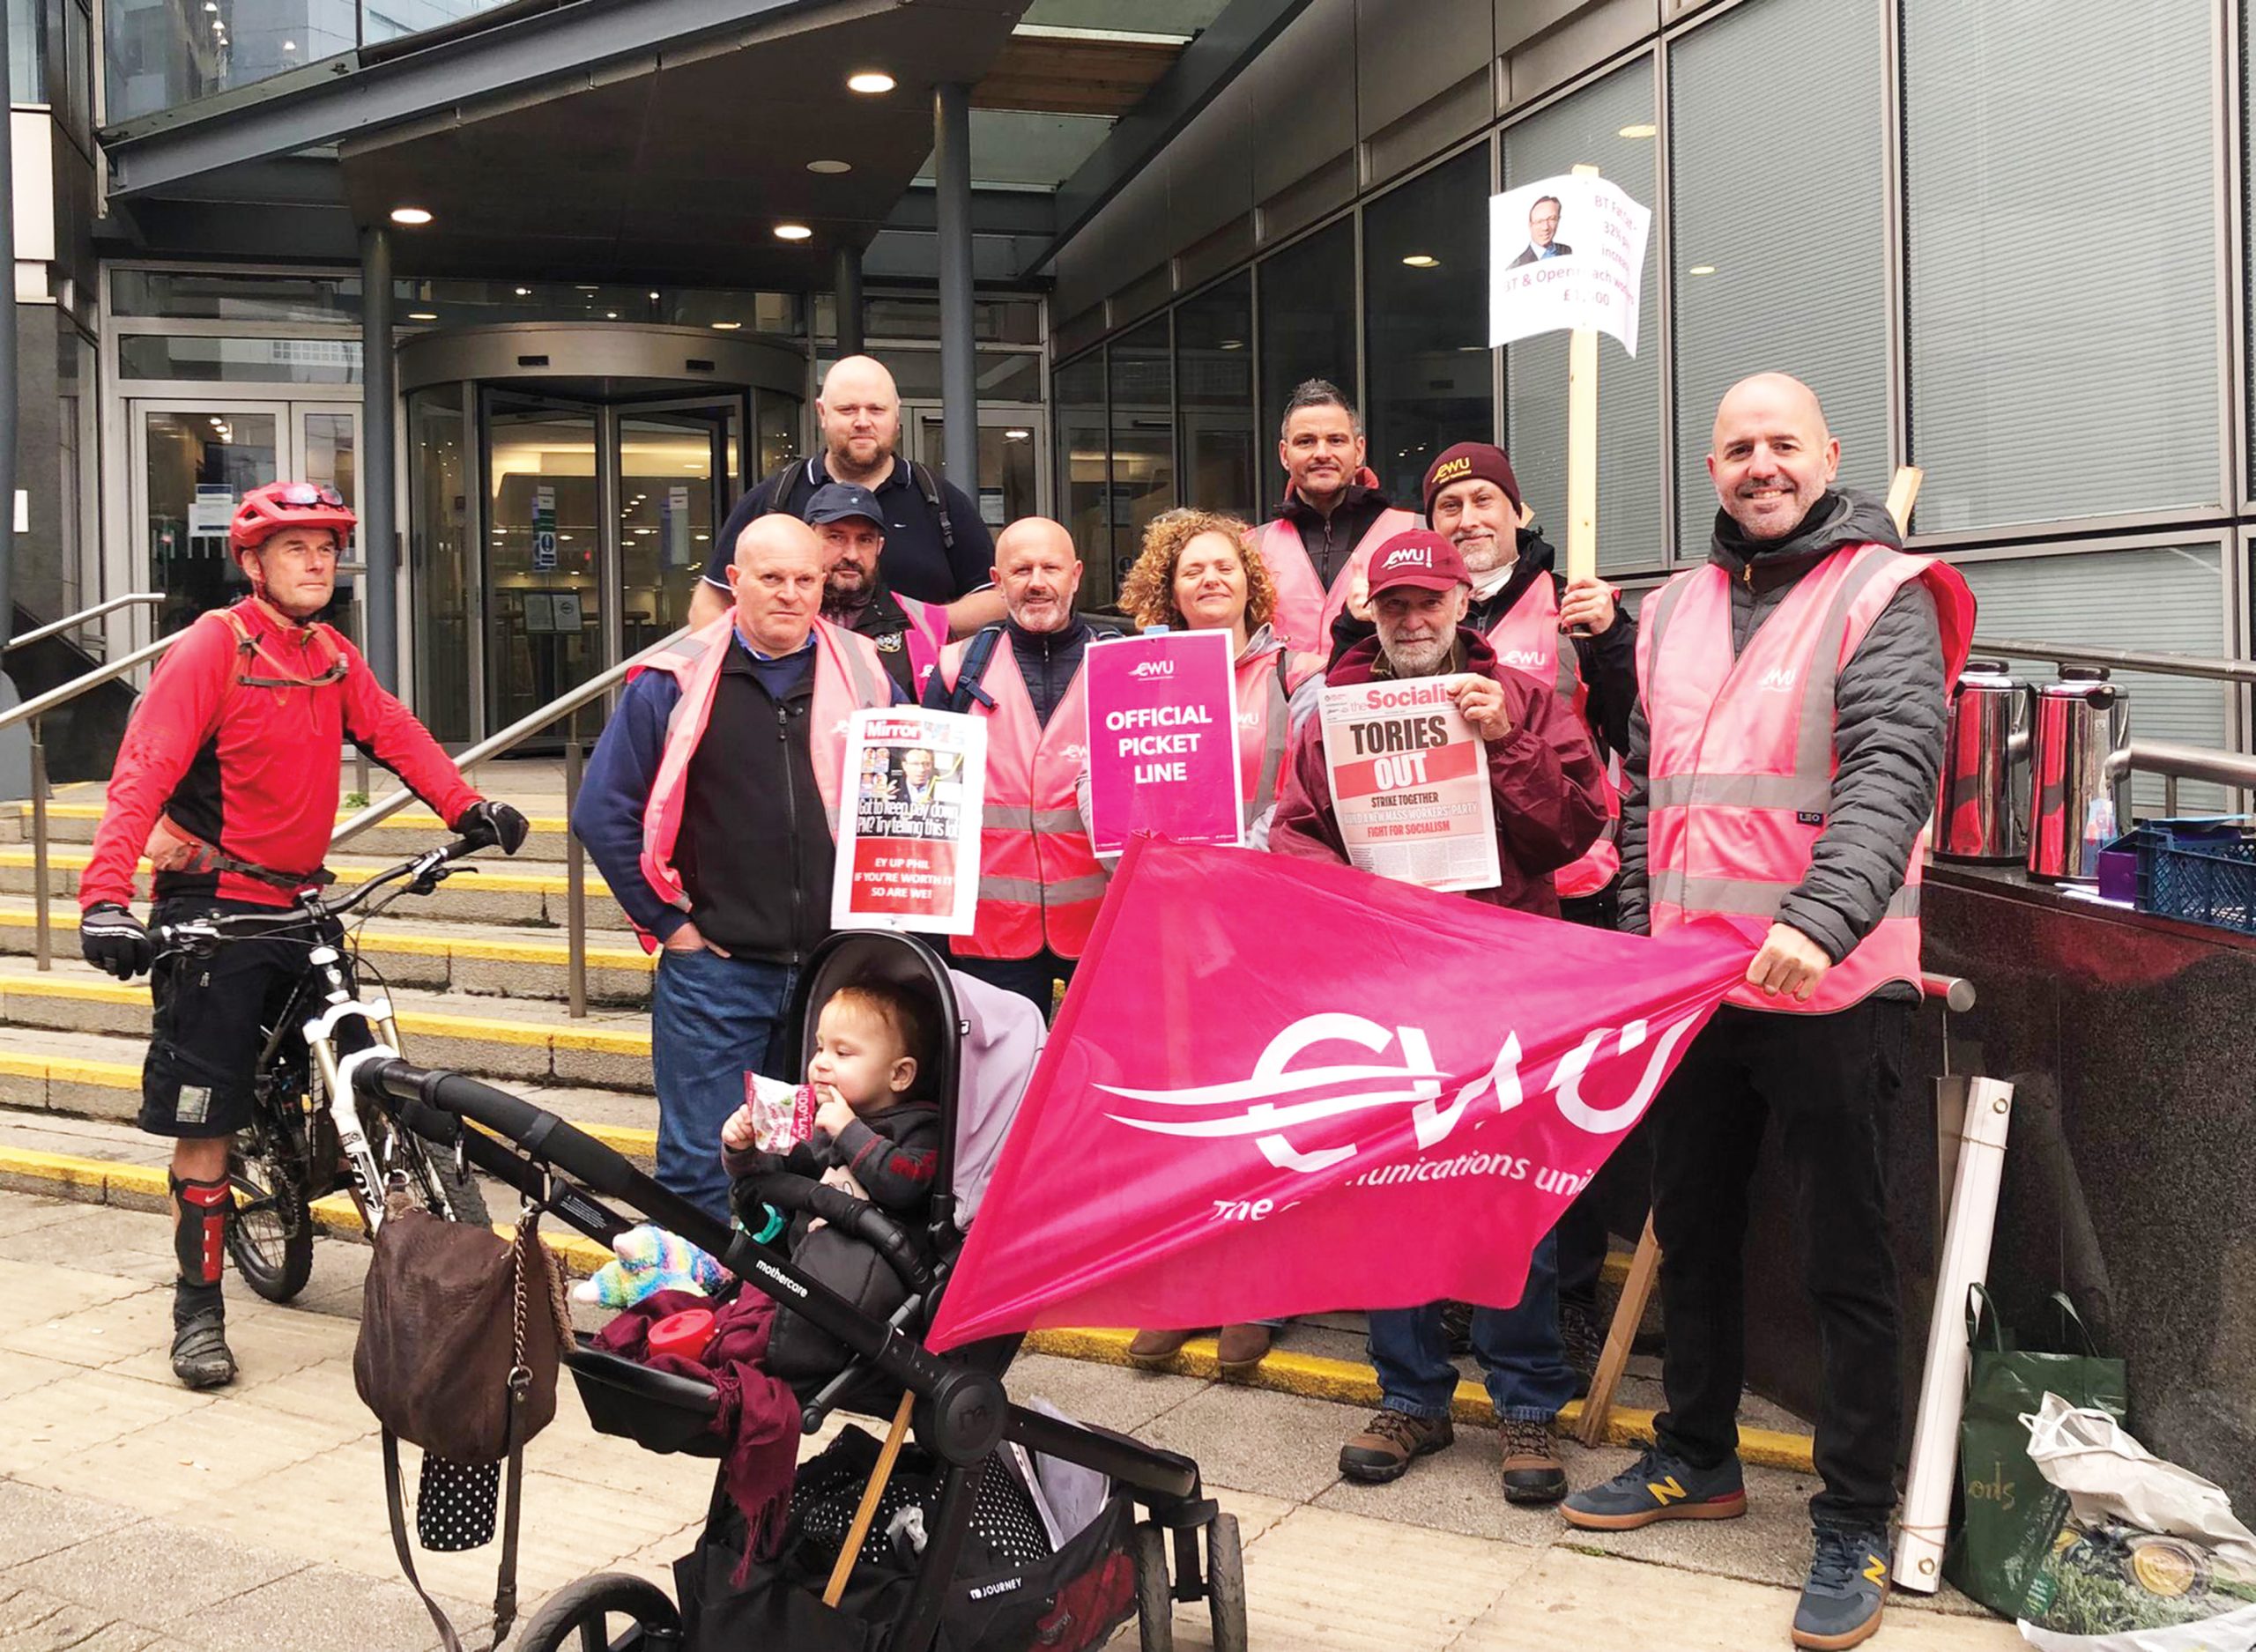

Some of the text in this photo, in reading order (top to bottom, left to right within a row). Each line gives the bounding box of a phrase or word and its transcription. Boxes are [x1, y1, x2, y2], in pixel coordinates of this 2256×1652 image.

[1595, 195, 1608, 209] BT
[1604, 220, 1621, 241] 32%
[1522, 273, 1532, 287] &
[1431, 456, 1470, 484] CWU
[1128, 661, 1175, 677] CWU
[1366, 683, 1447, 710] Sociali
[1106, 705, 1213, 731] OFFICIAL
[1236, 712, 1259, 726] WU
[866, 720, 919, 737] Mirror
[1349, 715, 1449, 755] TORIES
[1118, 733, 1201, 758] PICKET
[1134, 762, 1188, 785] LINE
[1373, 751, 1429, 791] OUT
[1371, 792, 1439, 809] STRIKE TOGETHER
[1385, 809, 1408, 822] MASS
[1451, 802, 1478, 816] PARTY
[1799, 812, 1821, 823] LEO
[892, 818, 924, 839] telling
[924, 819, 945, 837] this
[1368, 820, 1451, 838] FIGHT FOR SOCIALISM
[874, 857, 931, 870] EY UP PHIL
[854, 871, 862, 882] IF
[863, 872, 899, 883] YOU'RE
[901, 873, 941, 885] WORTH
[871, 887, 886, 897] SO
[887, 887, 909, 898] ARE
[755, 1259, 809, 1299] mothercare
[983, 1576, 1022, 1598] JOURNEY
